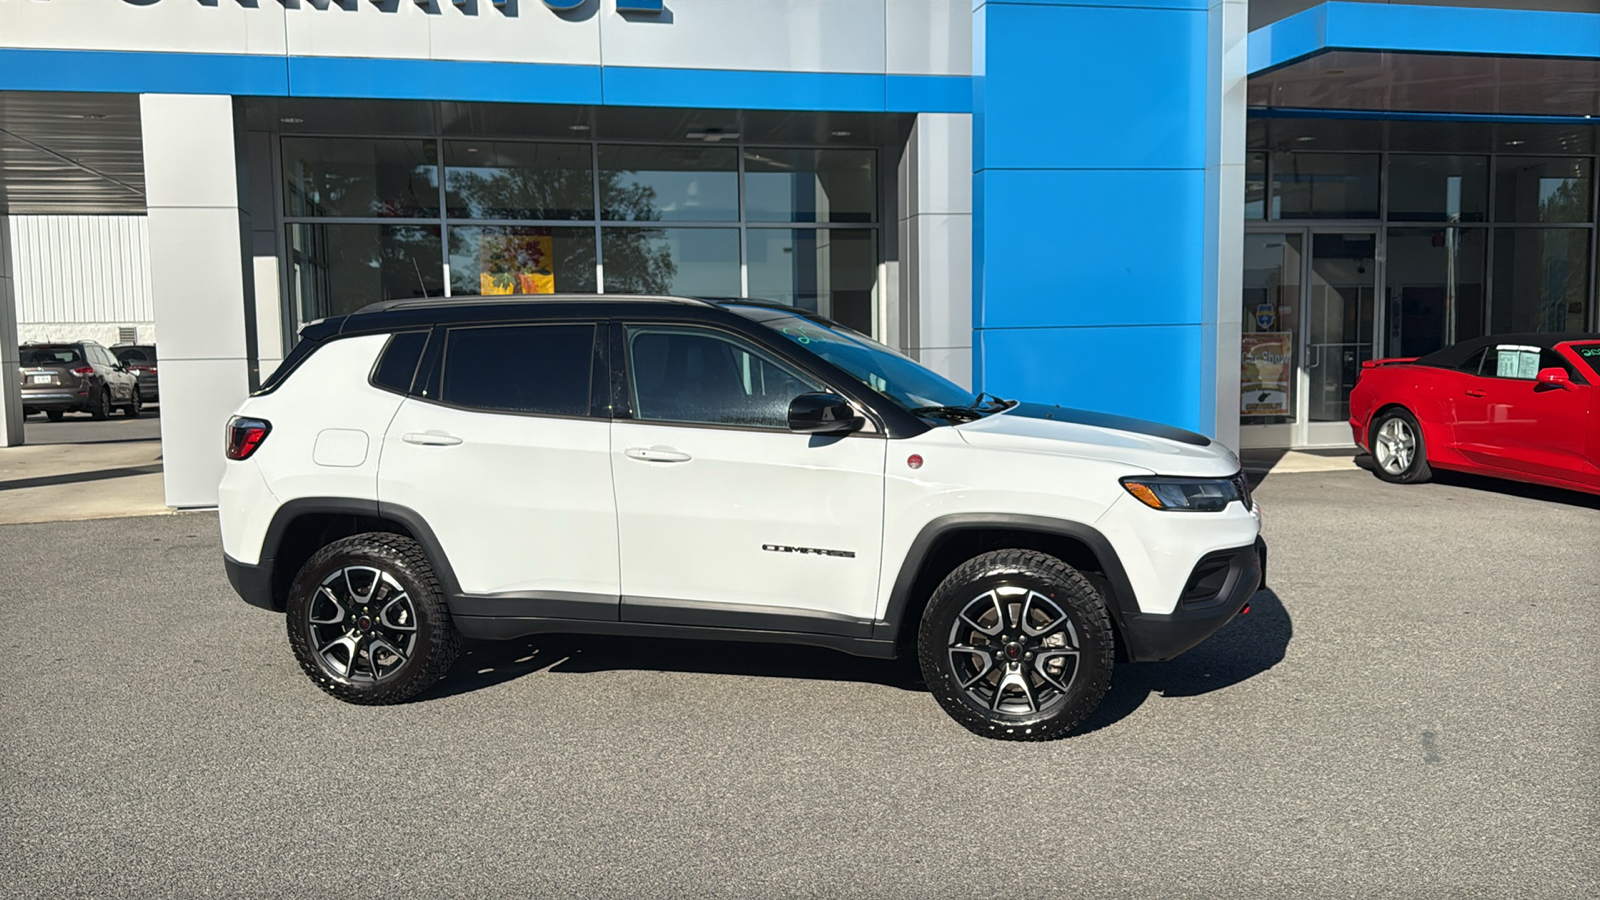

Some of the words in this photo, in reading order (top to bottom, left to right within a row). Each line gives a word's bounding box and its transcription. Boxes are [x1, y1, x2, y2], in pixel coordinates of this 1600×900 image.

[1242, 351, 1258, 365] Car
[1261, 350, 1289, 365] Show
[762, 544, 856, 558] COMPASS
